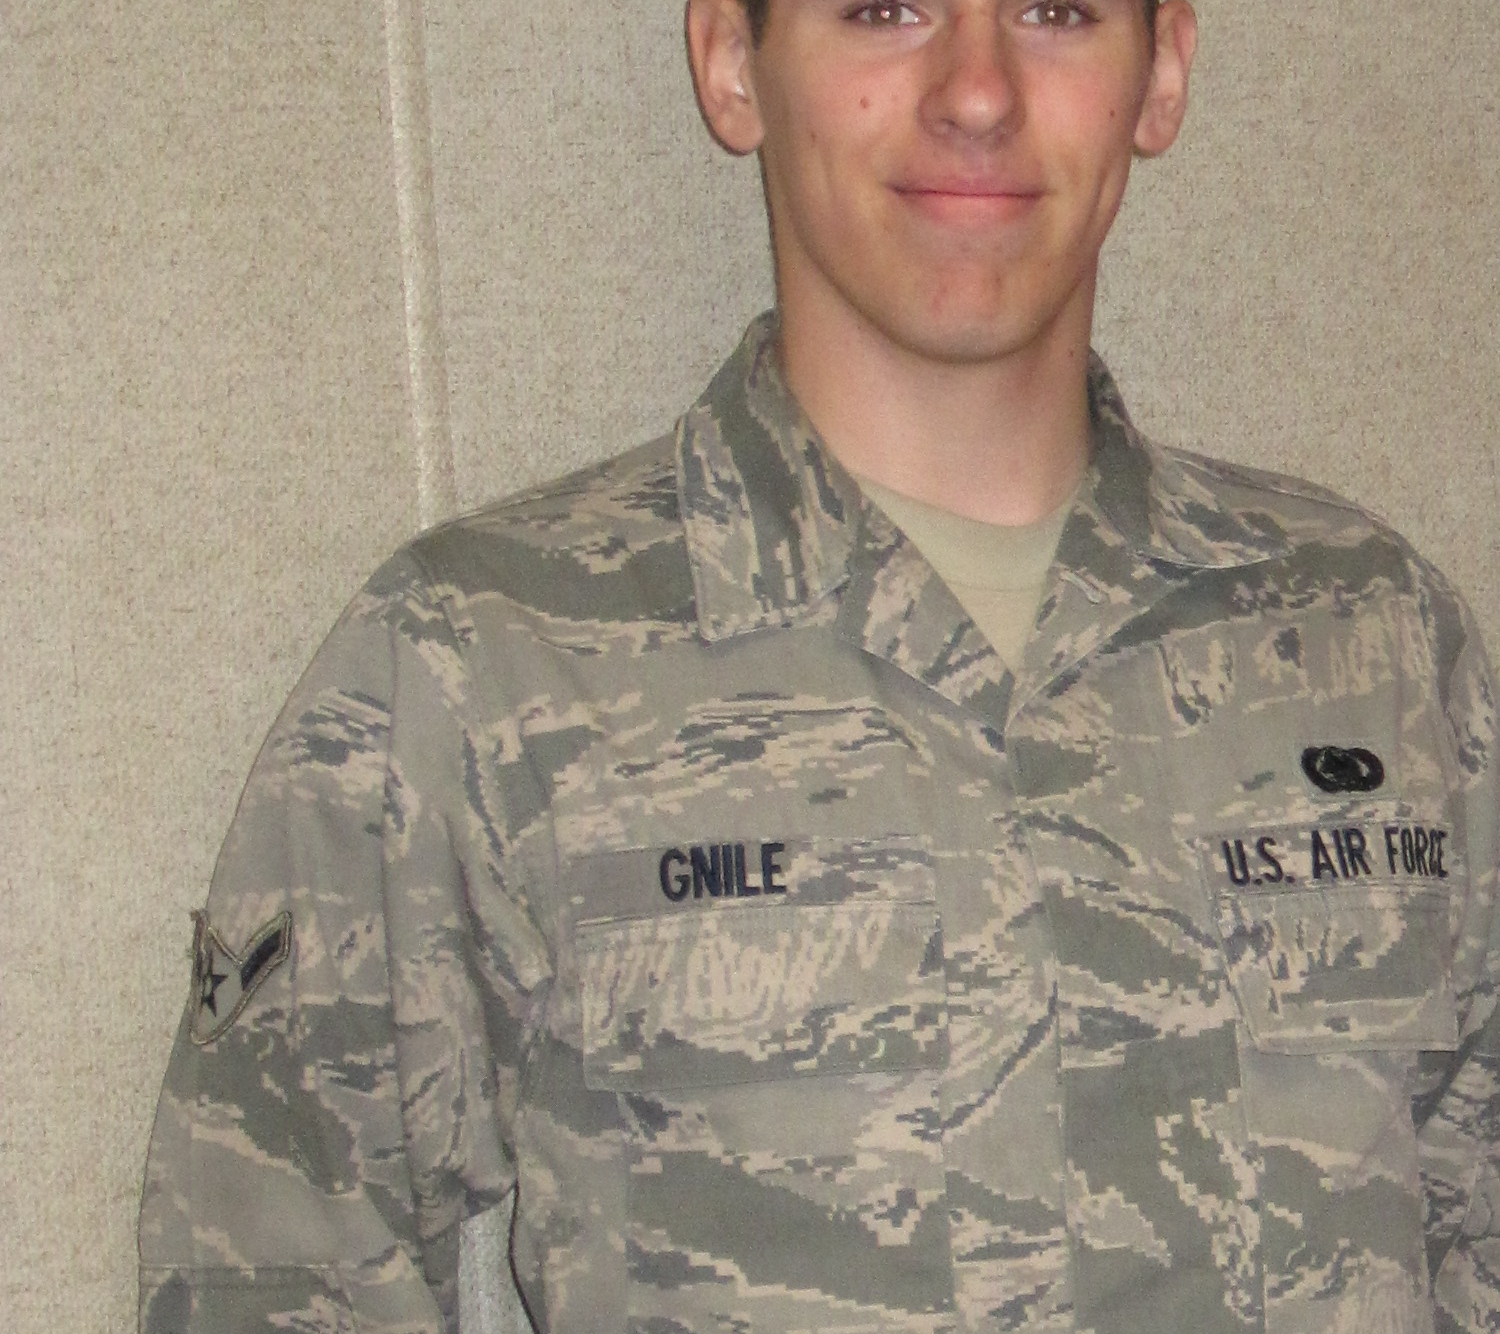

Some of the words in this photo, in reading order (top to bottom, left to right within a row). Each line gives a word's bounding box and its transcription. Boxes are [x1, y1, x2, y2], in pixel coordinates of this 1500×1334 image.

[660, 842, 787, 902] GNILE
[1222, 836, 1296, 886] U.S.
[1311, 827, 1372, 880] AIR
[1384, 825, 1449, 879] FORCE
